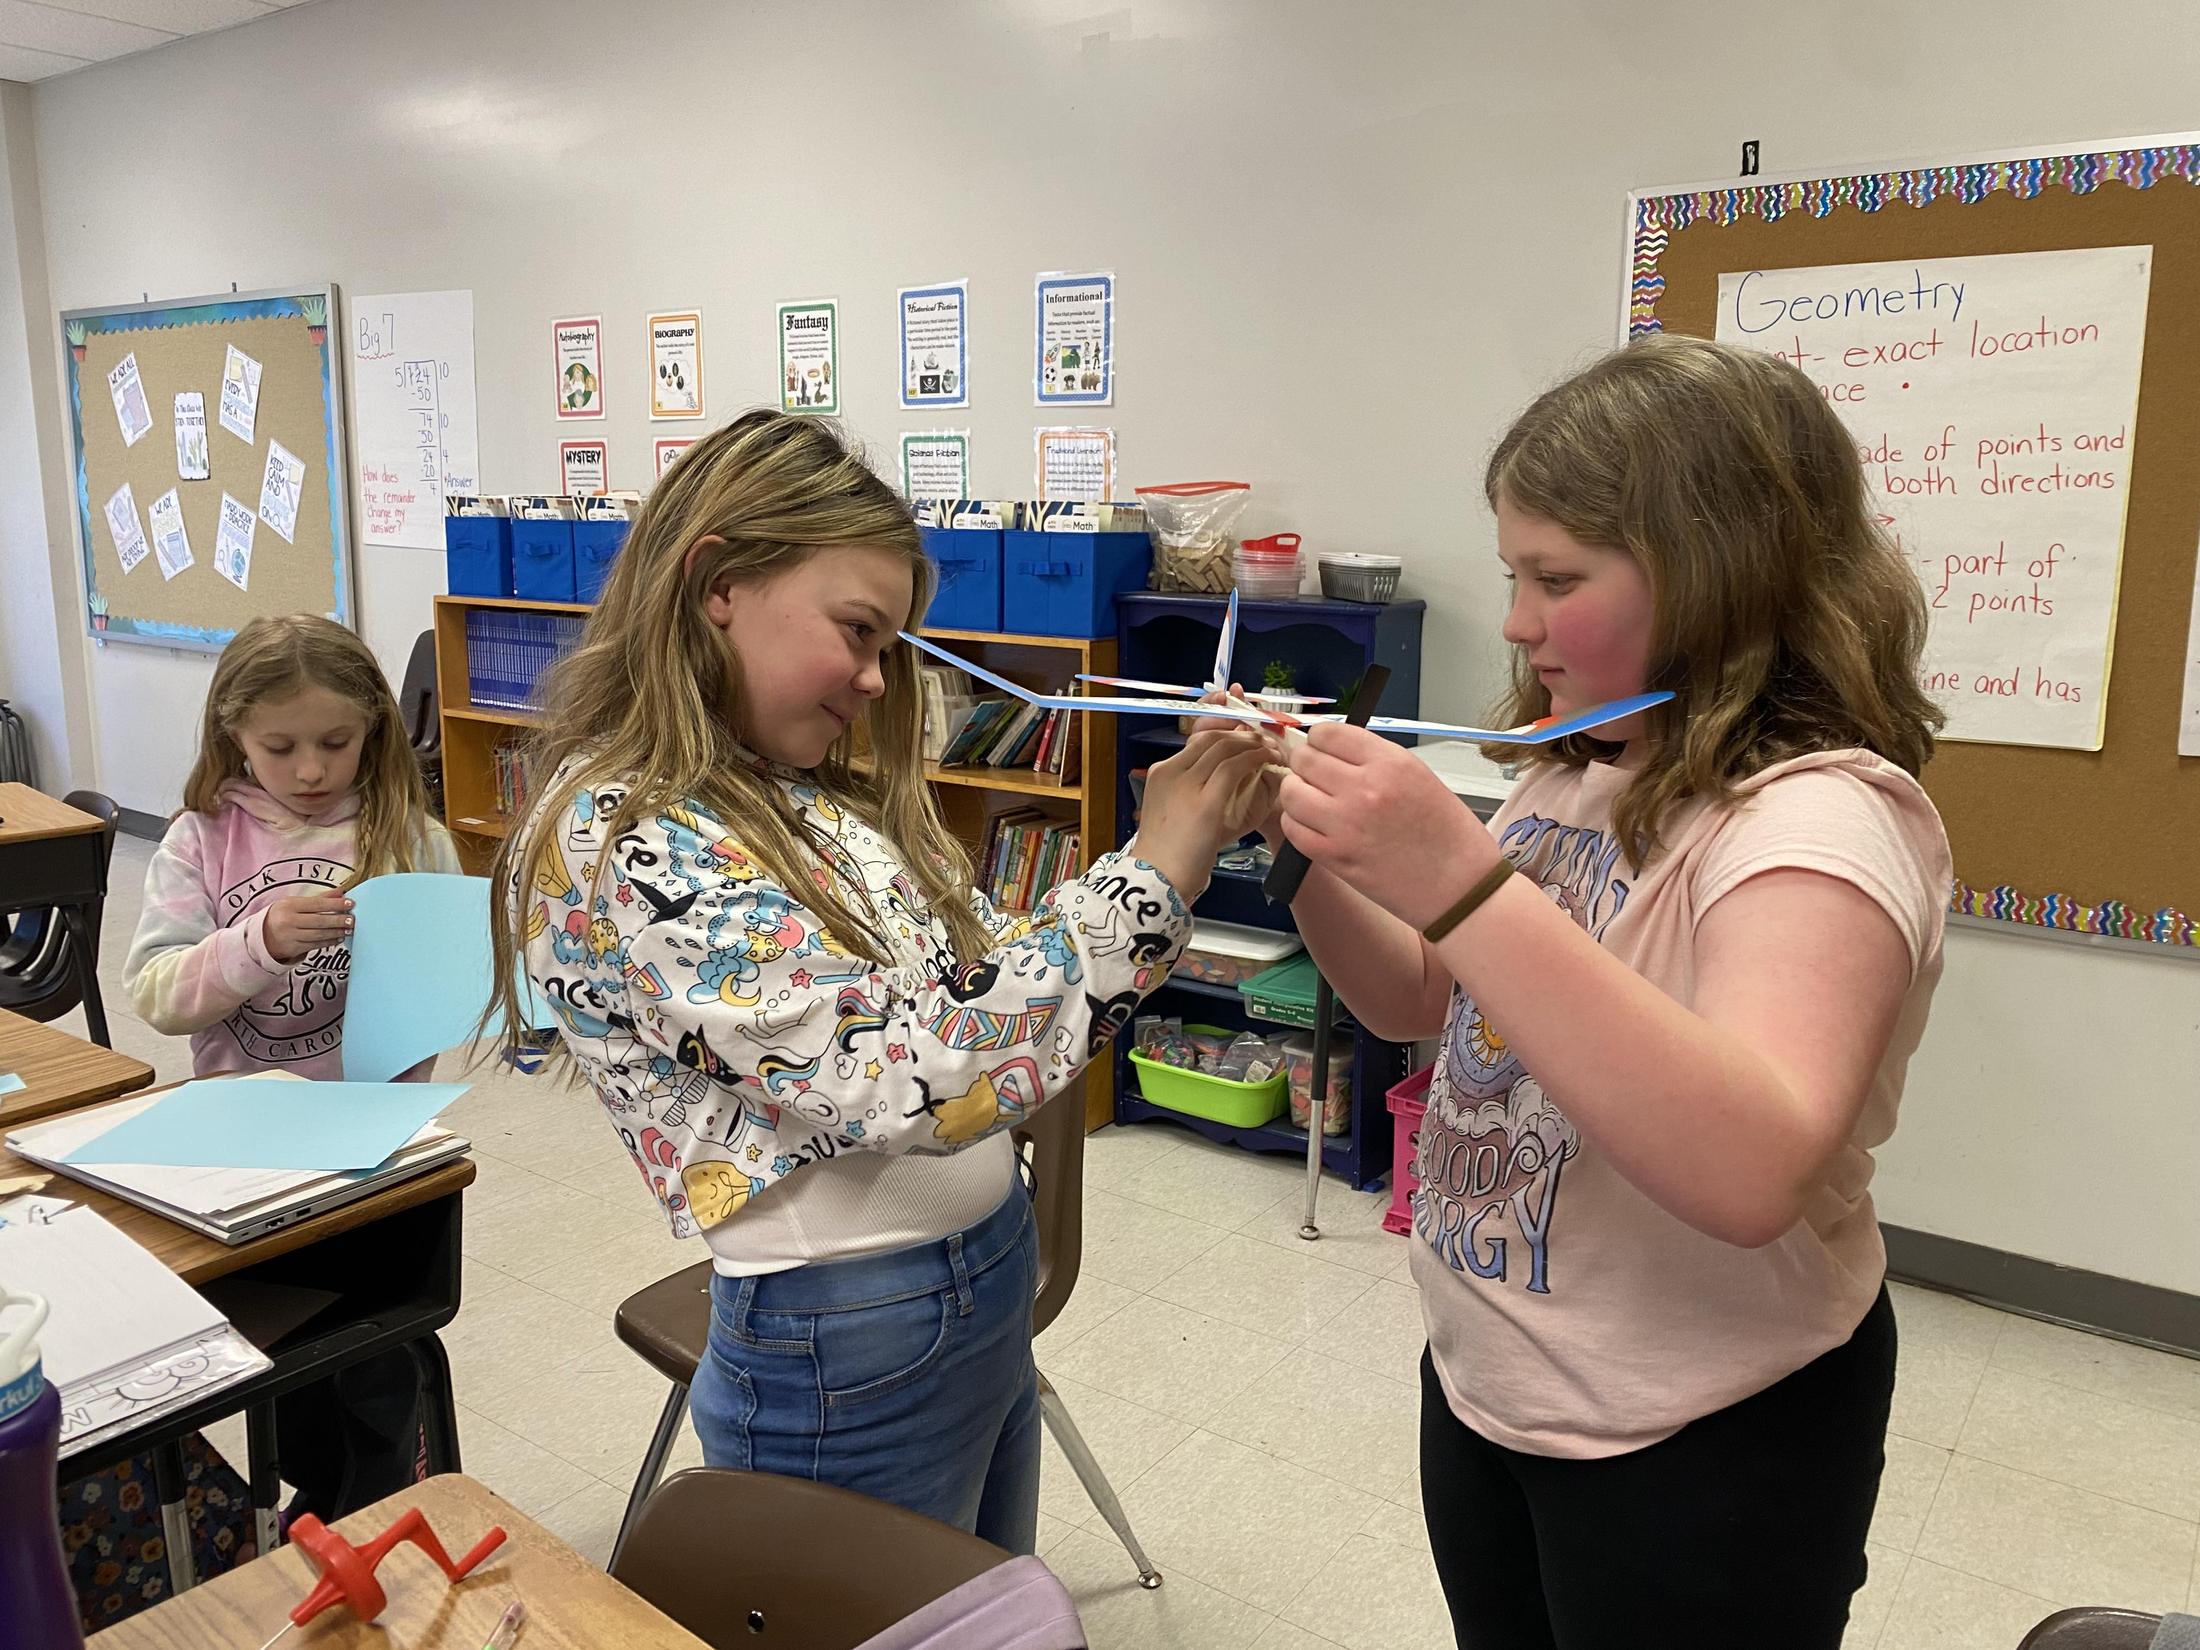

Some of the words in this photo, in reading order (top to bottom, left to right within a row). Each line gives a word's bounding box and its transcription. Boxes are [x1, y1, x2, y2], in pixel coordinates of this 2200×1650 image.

[907, 302, 936, 313] Historical
[936, 301, 958, 311] Fiction
[1046, 291, 1103, 303] Informational
[1736, 268, 1965, 333] Geometry
[360, 317, 380, 356] Big
[382, 313, 393, 350] 7
[558, 328, 594, 346] Autobiography
[786, 315, 828, 331] Fantasy
[1844, 327, 1944, 367] exact
[1971, 315, 2098, 358] location
[395, 367, 404, 388] 5
[566, 450, 601, 464] MYSTERY
[1859, 434, 1904, 464] ade
[1923, 425, 1956, 463] of
[1978, 423, 2062, 468] points
[2074, 425, 2125, 454] and
[1885, 469, 1958, 496] both
[1980, 459, 2116, 496] directions
[980, 520, 998, 529] Math
[1072, 521, 1094, 531] Math
[1944, 540, 2009, 590] part
[2028, 543, 2066, 579] of
[1931, 585, 1949, 609] 2
[1968, 582, 2054, 624] points
[1922, 669, 1961, 691] ine
[1973, 666, 2020, 697] and
[2034, 666, 2081, 704] has
[228, 869, 277, 909] OAK
[297, 863, 345, 884] ISL
[1423, 1129, 1500, 1199] OOD
[1430, 1139, 1568, 1295] RGY
